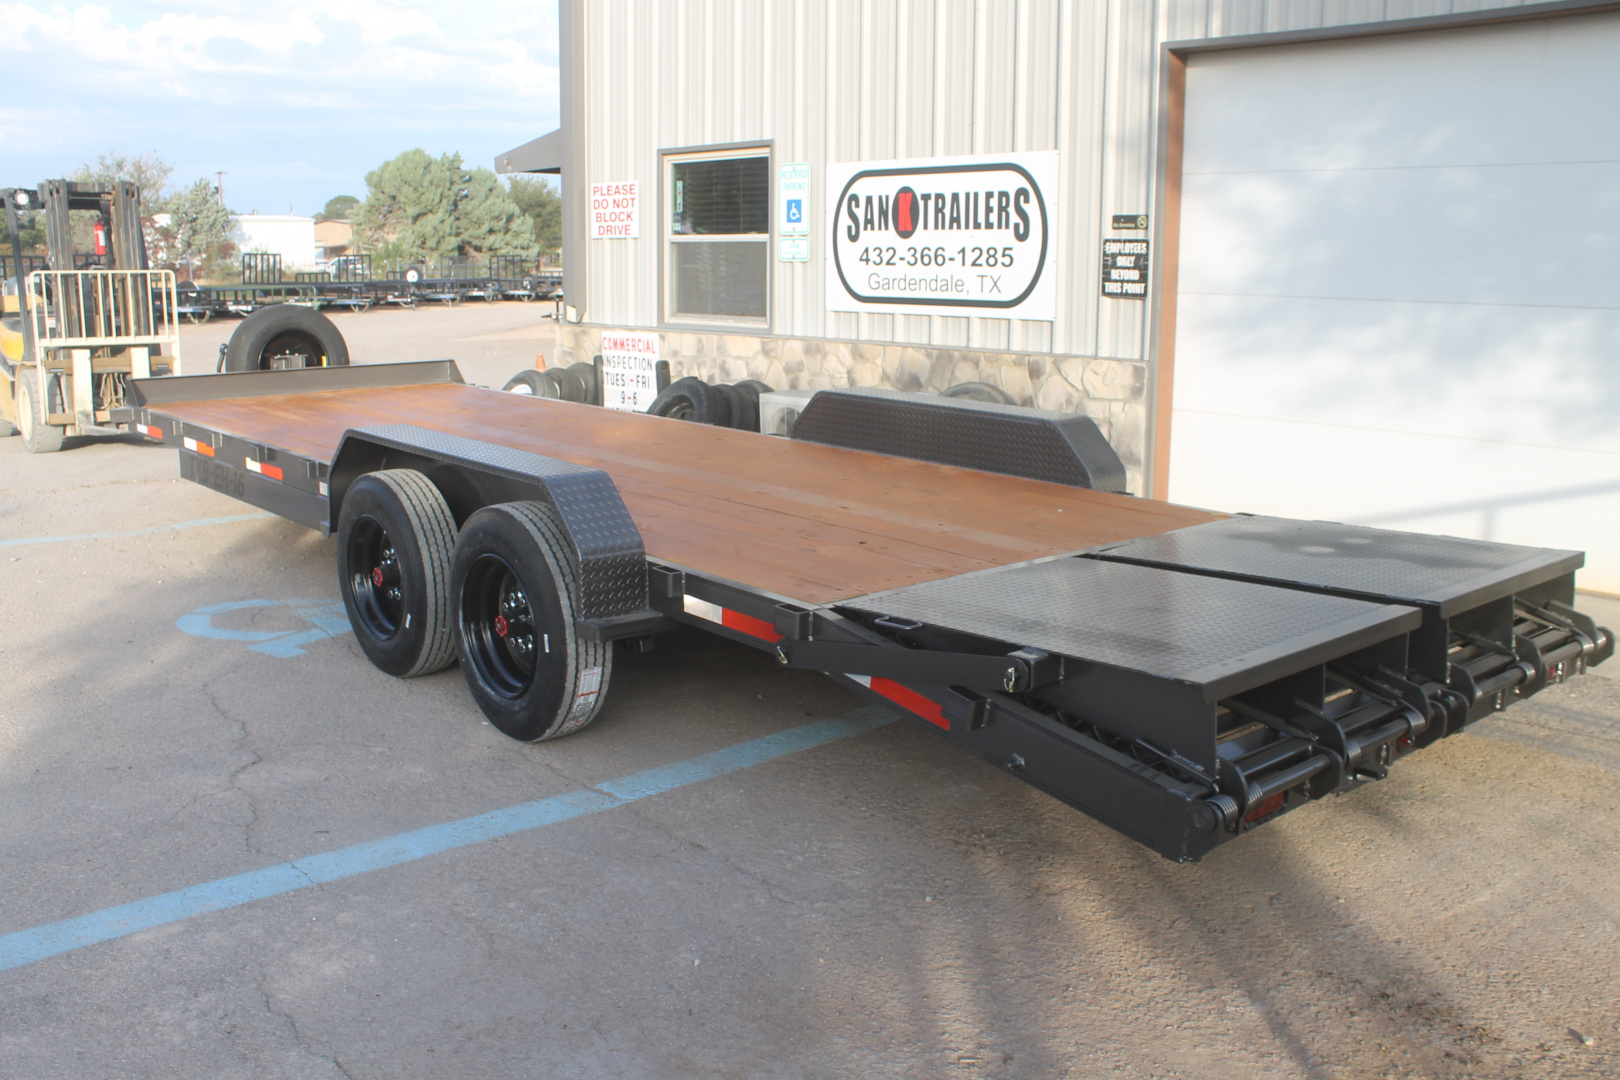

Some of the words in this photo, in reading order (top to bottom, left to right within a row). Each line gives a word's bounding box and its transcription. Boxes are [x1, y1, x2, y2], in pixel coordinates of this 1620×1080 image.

[781, 169, 808, 179] RESERVED
[593, 184, 636, 197] PLEASE
[783, 182, 806, 191] PARKING
[593, 199, 609, 210] DO
[612, 197, 636, 209] NOT
[595, 211, 634, 223] BLOCK
[847, 193, 889, 242] SAN
[921, 187, 1030, 242] TRAILERS
[598, 224, 631, 236] DRIVE
[1104, 242, 1147, 254] EMPLOYEES
[859, 246, 1014, 267] 432-366-1285
[1116, 255, 1136, 267] ONLY
[1111, 268, 1140, 281] BEYOND
[868, 272, 969, 295] Gardendale,
[977, 275, 1002, 294] TX
[1104, 282, 1122, 293] THIS
[1122, 282, 1146, 294] POINT
[602, 336, 656, 354] COMMERCIAL
[604, 354, 653, 371] INSPECTION
